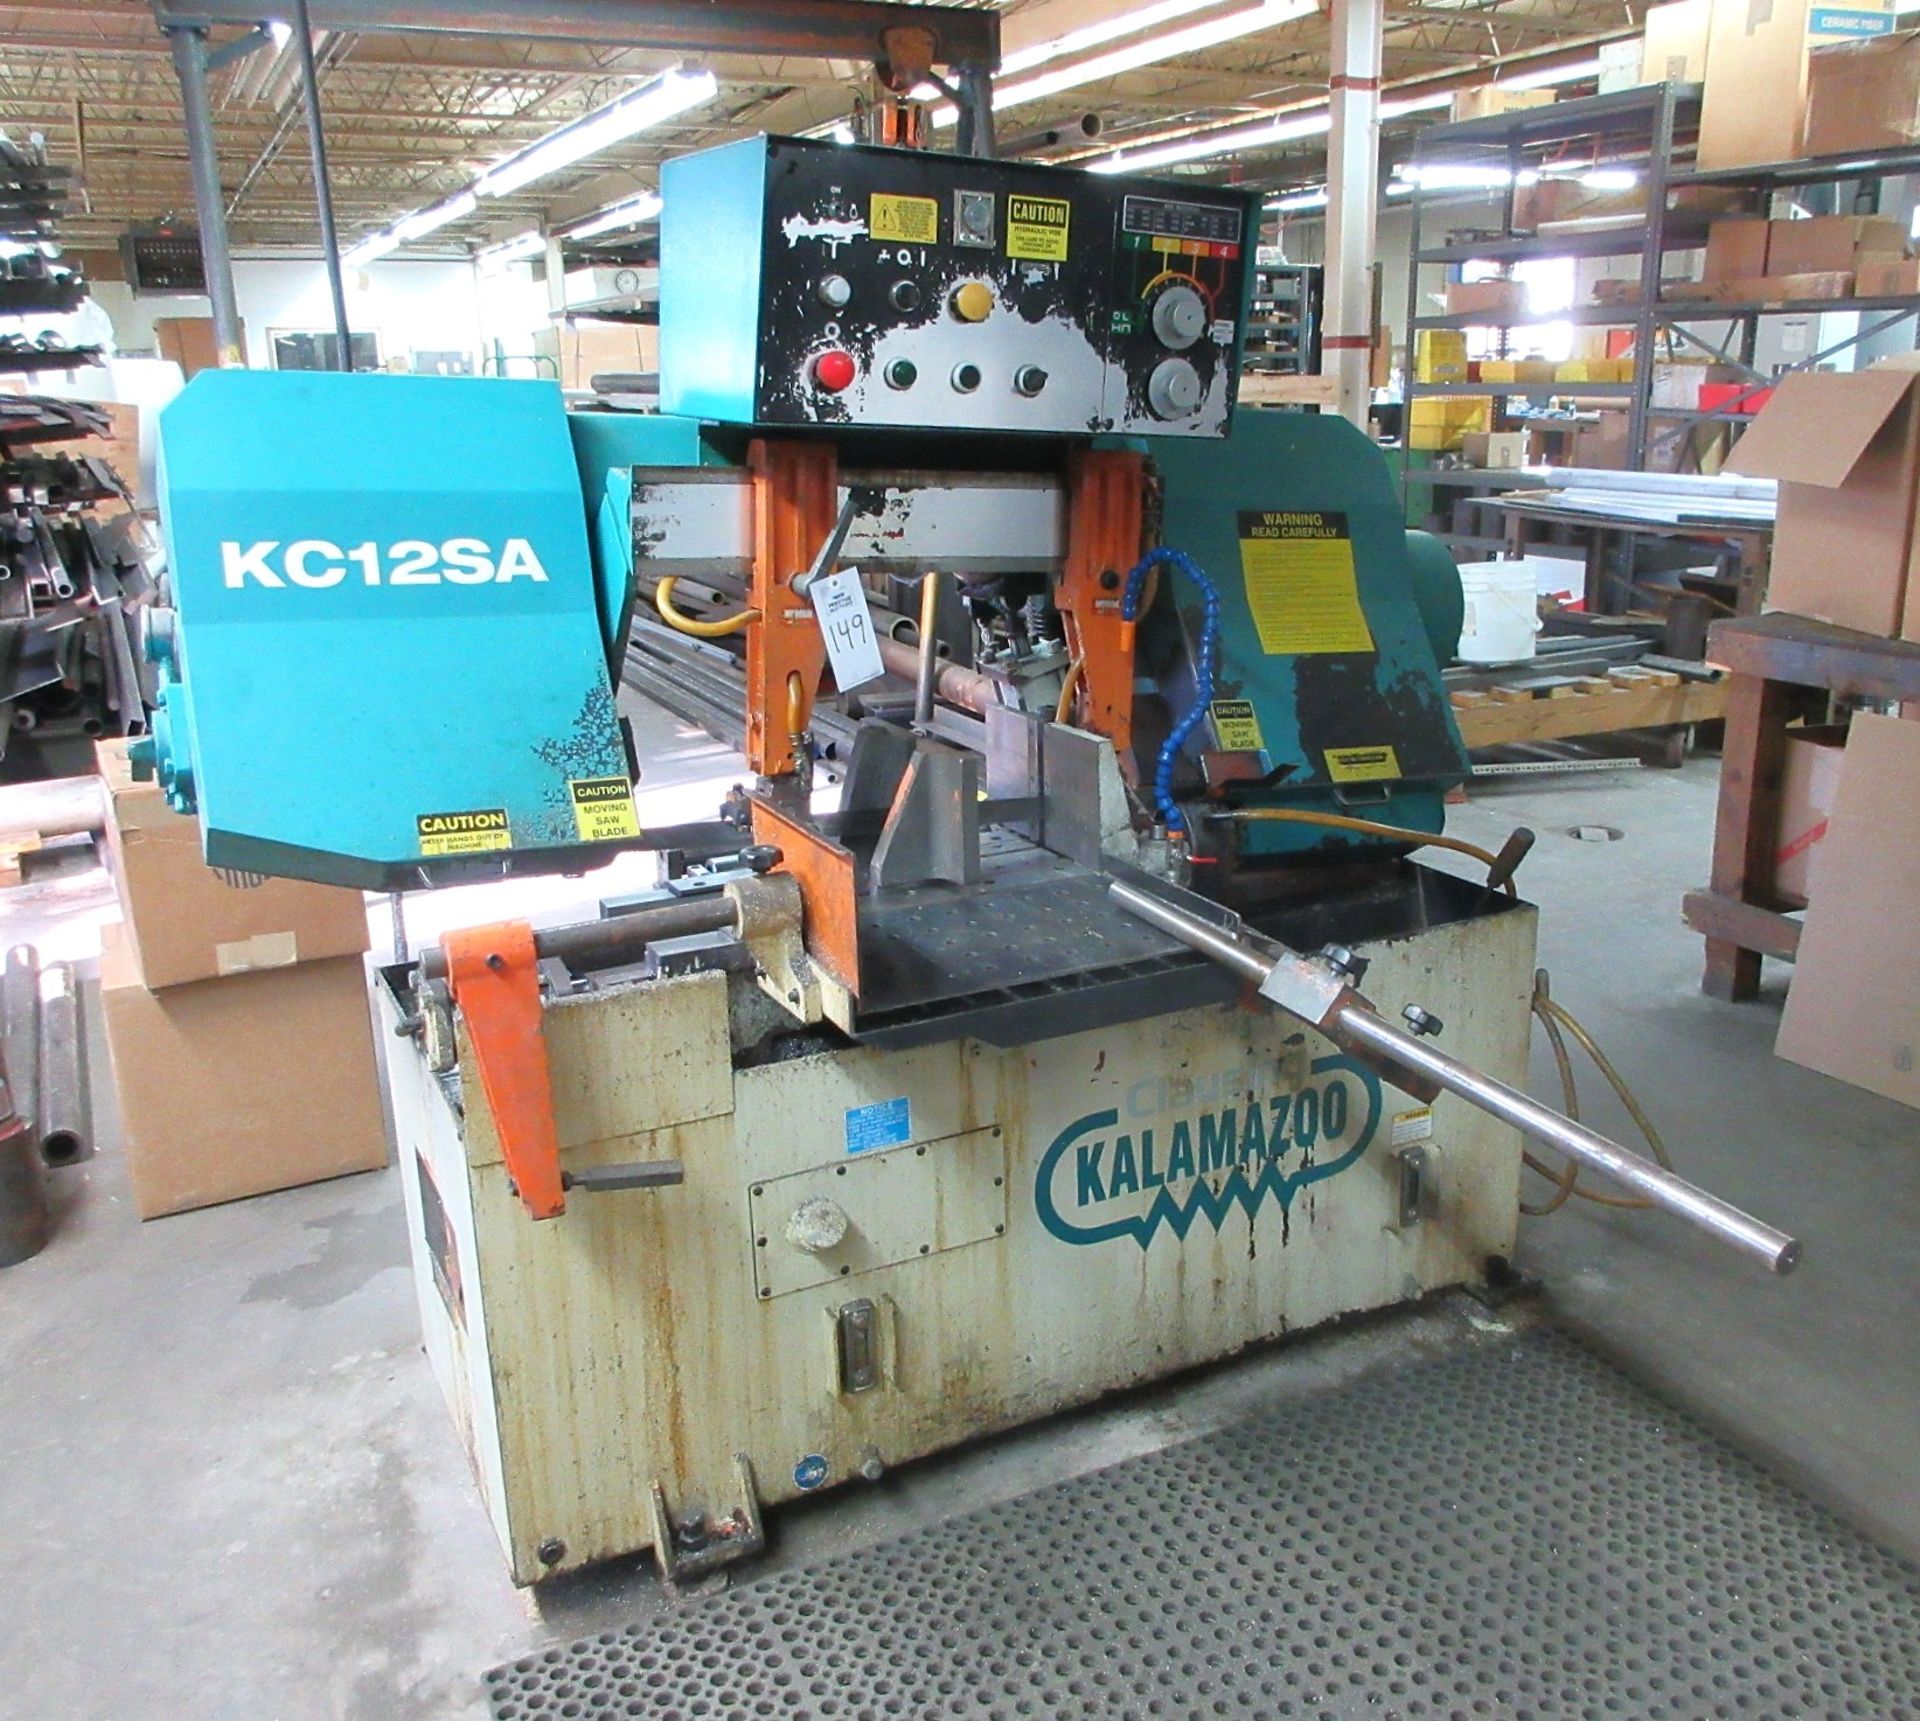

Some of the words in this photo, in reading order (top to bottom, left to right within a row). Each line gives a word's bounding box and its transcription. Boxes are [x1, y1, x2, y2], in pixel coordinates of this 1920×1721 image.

[1014, 203, 1064, 224] CAUTION
[1015, 226, 1047, 235] HYDRAULIC
[1191, 243, 1200, 255] 3
[1220, 246, 1228, 257] 4
[1263, 512, 1323, 526] WARNING
[1251, 526, 1279, 537] READ
[1281, 527, 1337, 538] CAREFULLY
[220, 538, 550, 589] KC12SA
[829, 613, 867, 653] 149
[1216, 705, 1251, 715] CAUTION
[577, 785, 627, 797] CAUTION
[583, 803, 628, 814] MOVING
[420, 813, 505, 832] CAUTION
[595, 815, 620, 825] SAW
[592, 826, 630, 838] BLADE
[1077, 1080, 1348, 1207] KALAMAZOO
